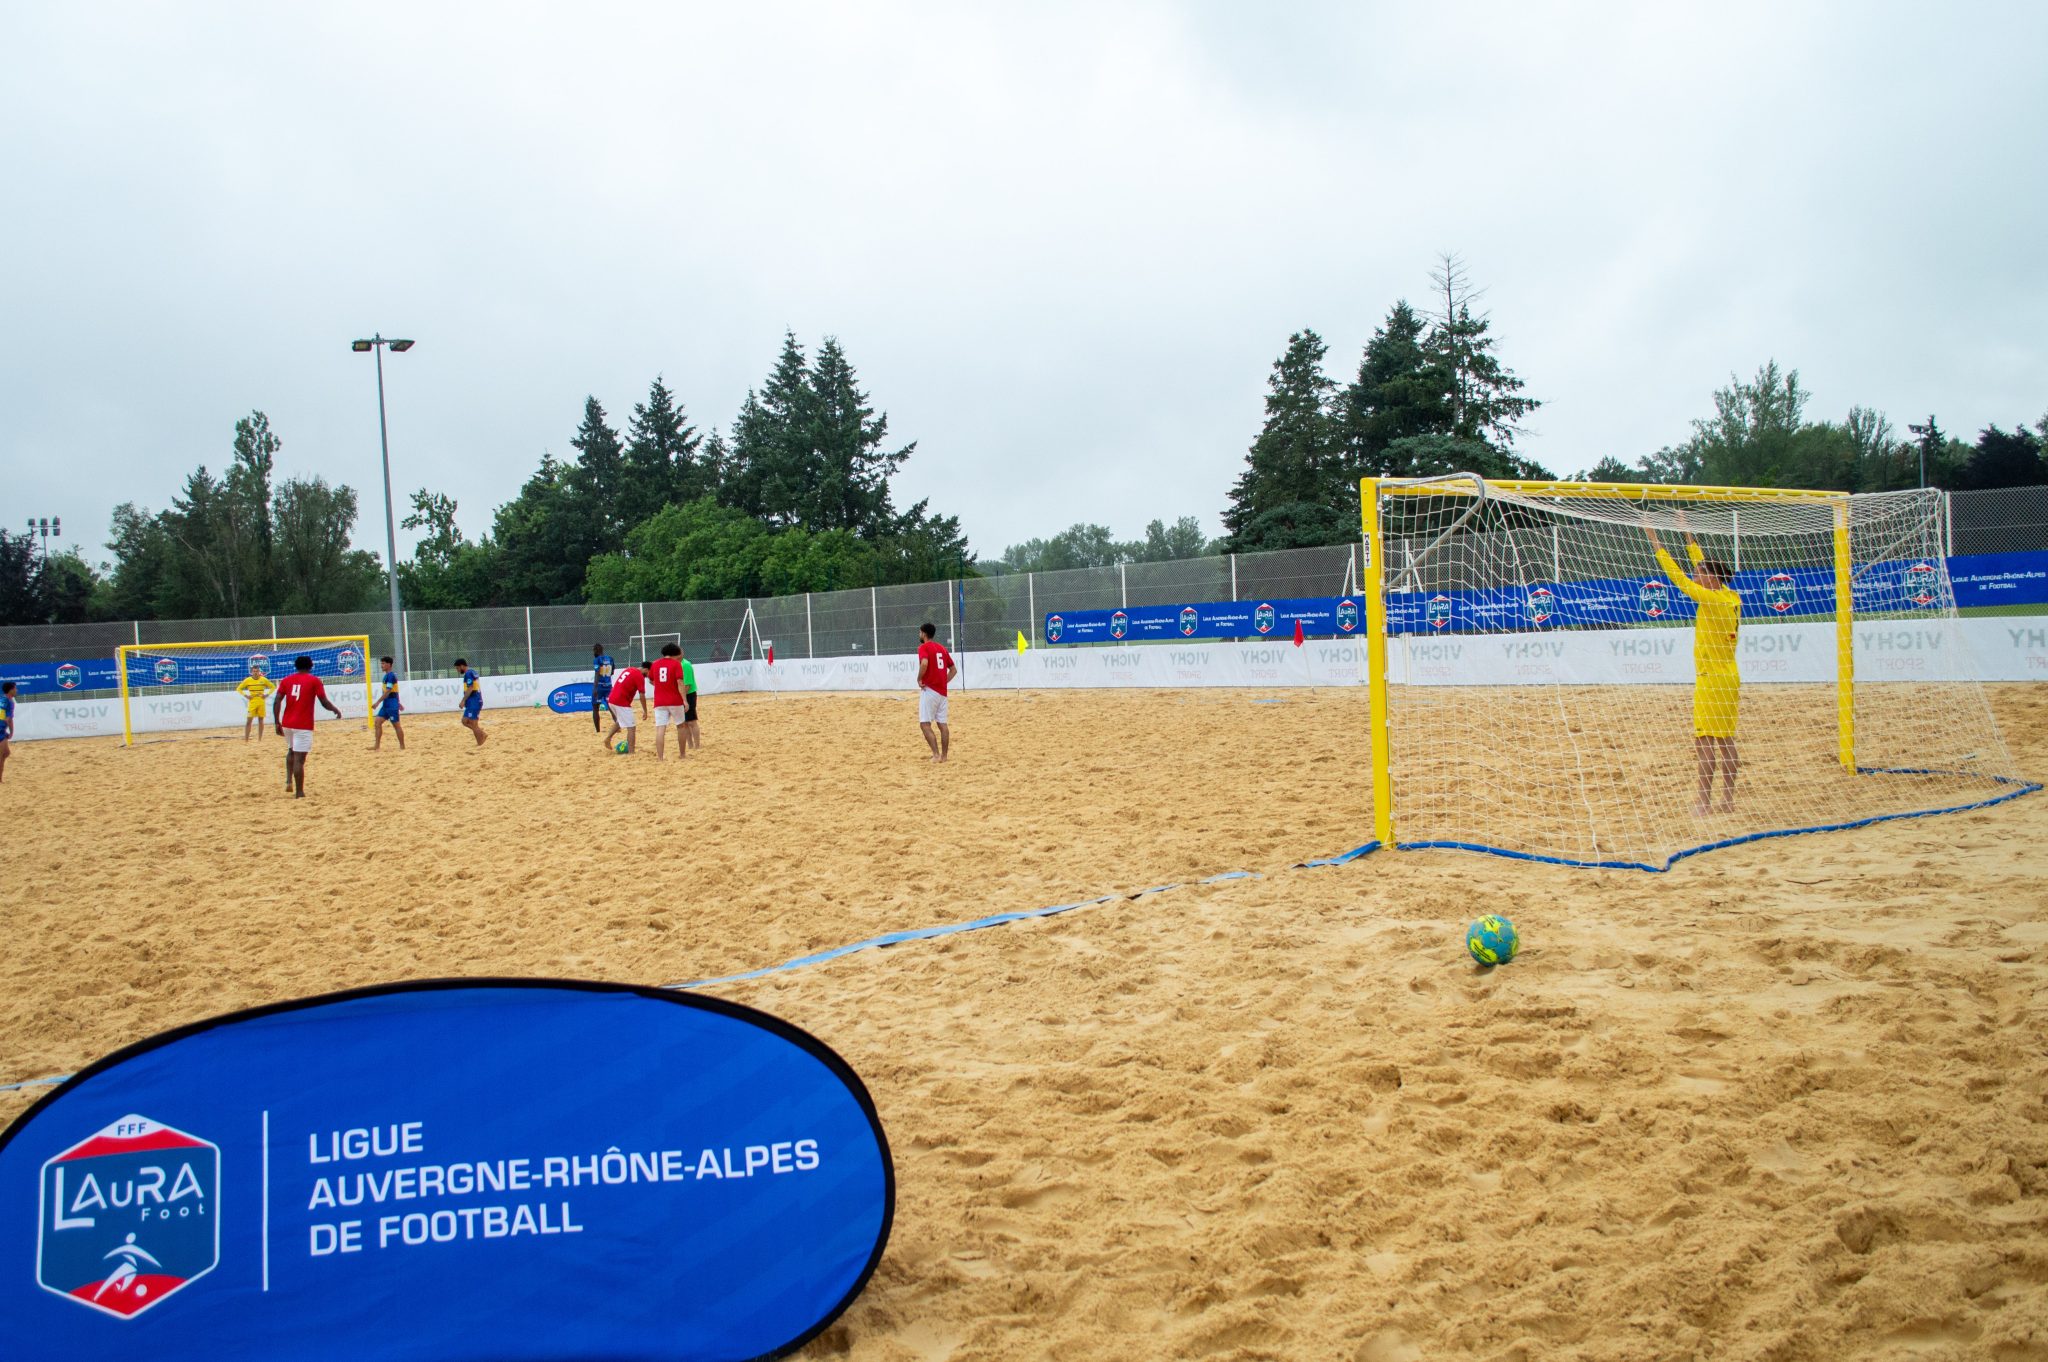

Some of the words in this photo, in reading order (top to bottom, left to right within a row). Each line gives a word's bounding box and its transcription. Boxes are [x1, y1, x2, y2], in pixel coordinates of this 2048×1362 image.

[936, 652, 945, 669] 6
[618, 671, 630, 683] 5
[659, 667, 668, 683] 8
[291, 684, 301, 701] 4
[117, 1122, 147, 1136] FFF
[310, 1121, 423, 1164] LIGUE
[308, 1139, 820, 1210] AUVERGNE-RHÔNE-ALPES
[310, 1221, 363, 1256] DE
[379, 1202, 583, 1248] FOOTBALL
